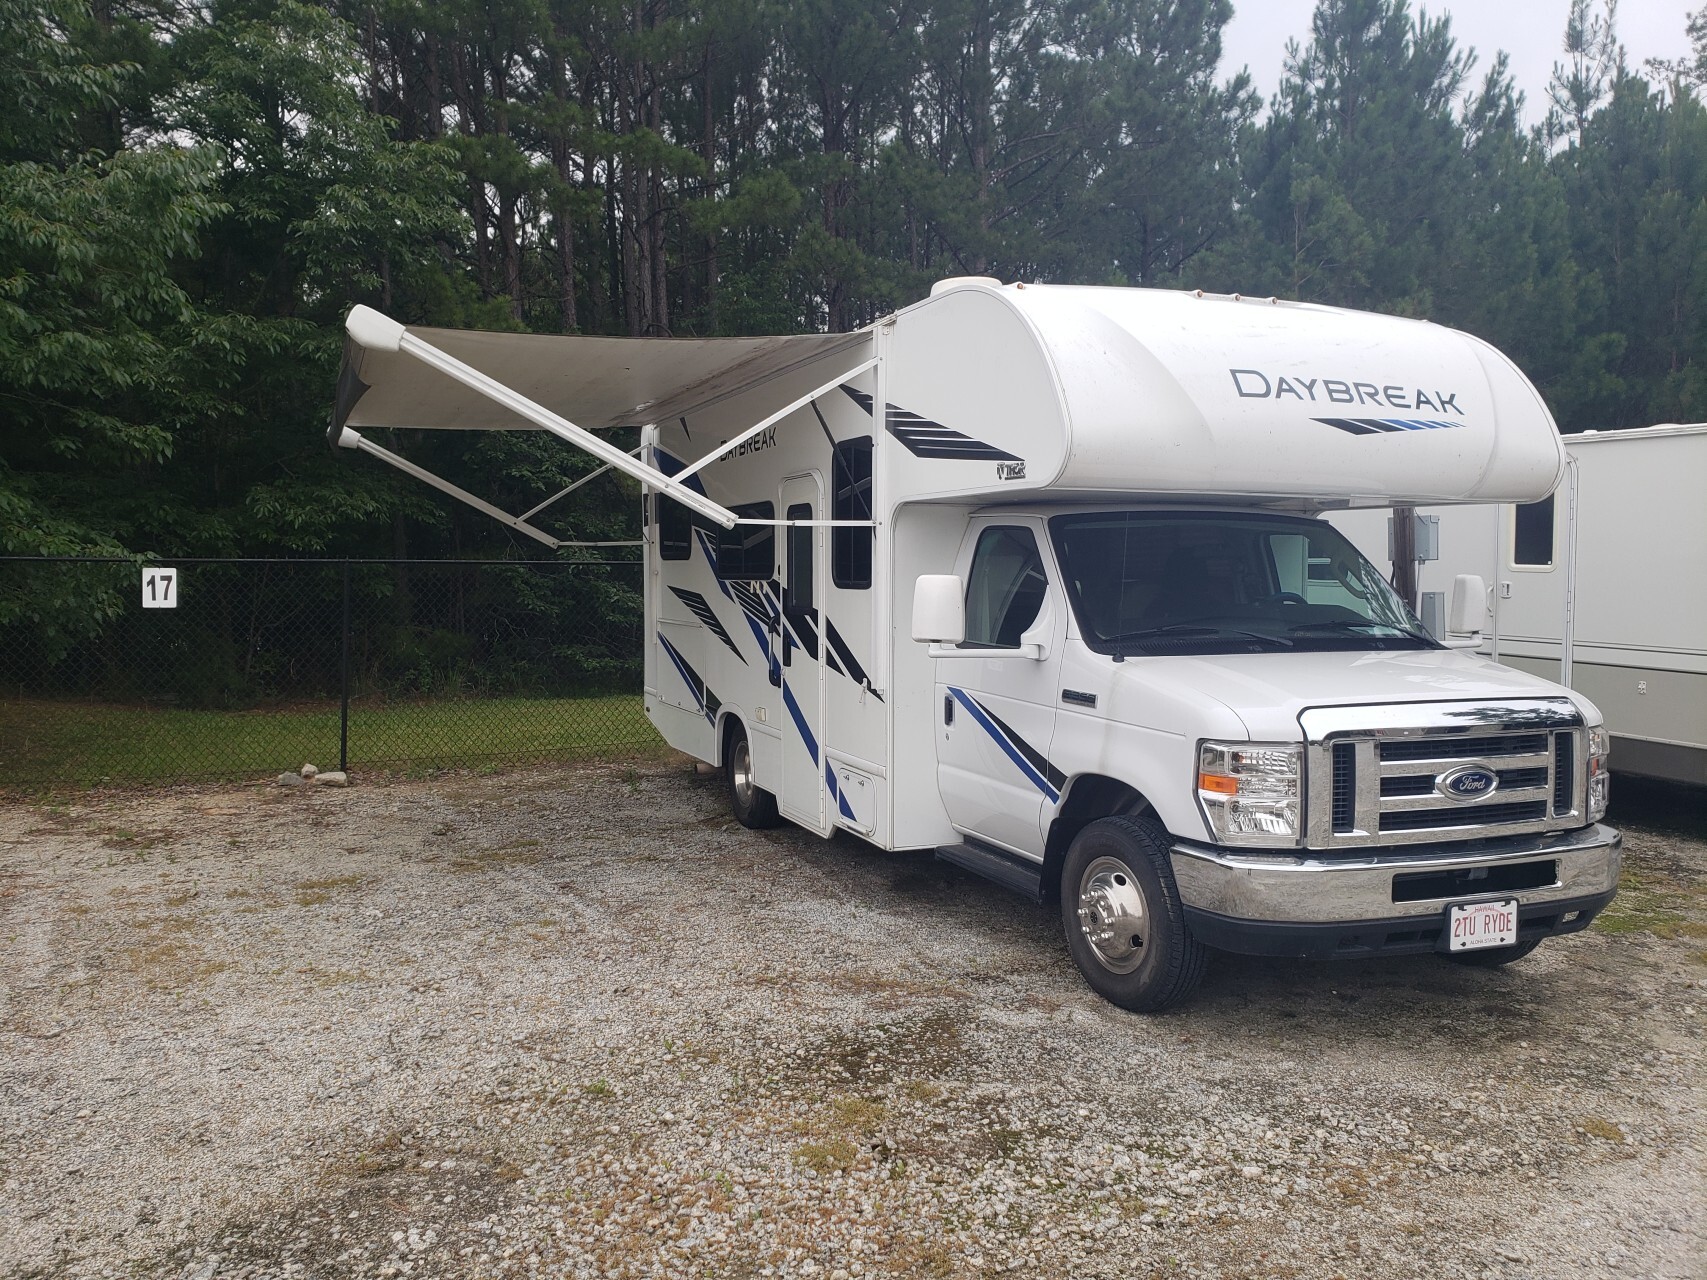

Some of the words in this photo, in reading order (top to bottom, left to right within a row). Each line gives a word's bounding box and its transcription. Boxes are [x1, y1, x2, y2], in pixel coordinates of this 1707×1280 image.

[1229, 368, 1465, 416] DAYBREAK
[146, 574, 173, 601] 17
[1459, 775, 1486, 790] Ford
[1454, 916, 1476, 937] 2TU
[1483, 912, 1513, 935] RYDE
